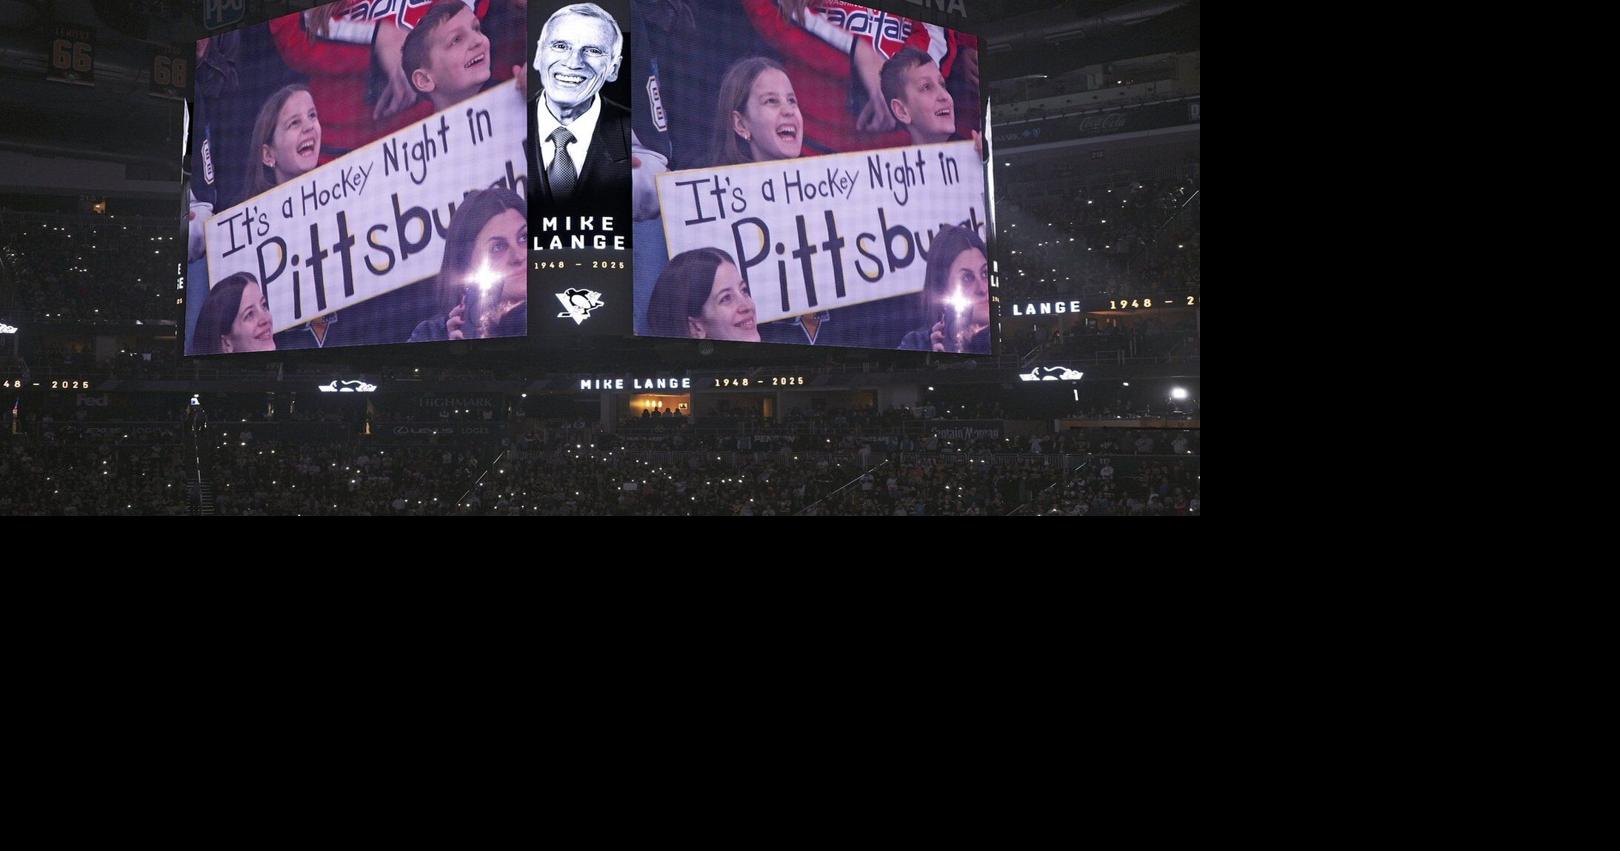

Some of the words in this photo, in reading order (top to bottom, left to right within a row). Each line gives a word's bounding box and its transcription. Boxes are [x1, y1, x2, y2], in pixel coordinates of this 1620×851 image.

[53, 39, 92, 72] 66
[217, 206, 270, 258] It's
[282, 197, 293, 219] a
[383, 115, 449, 184] Night
[468, 107, 493, 147] in
[675, 174, 747, 226] It's
[762, 178, 776, 203] a
[867, 149, 926, 206] Night
[939, 151, 960, 186] in
[543, 216, 614, 232] MIKE
[533, 234, 625, 251] LANGE
[534, 261, 565, 270] 1948
[593, 261, 625, 269] 2025
[1013, 300, 1081, 316] LANGE
[1110, 298, 1152, 310] 1948
[52, 381, 89, 389] 2025
[580, 379, 624, 390] MIKE
[634, 377, 691, 389] LANGE
[715, 378, 749, 387] 1948
[772, 377, 804, 386] 2025
